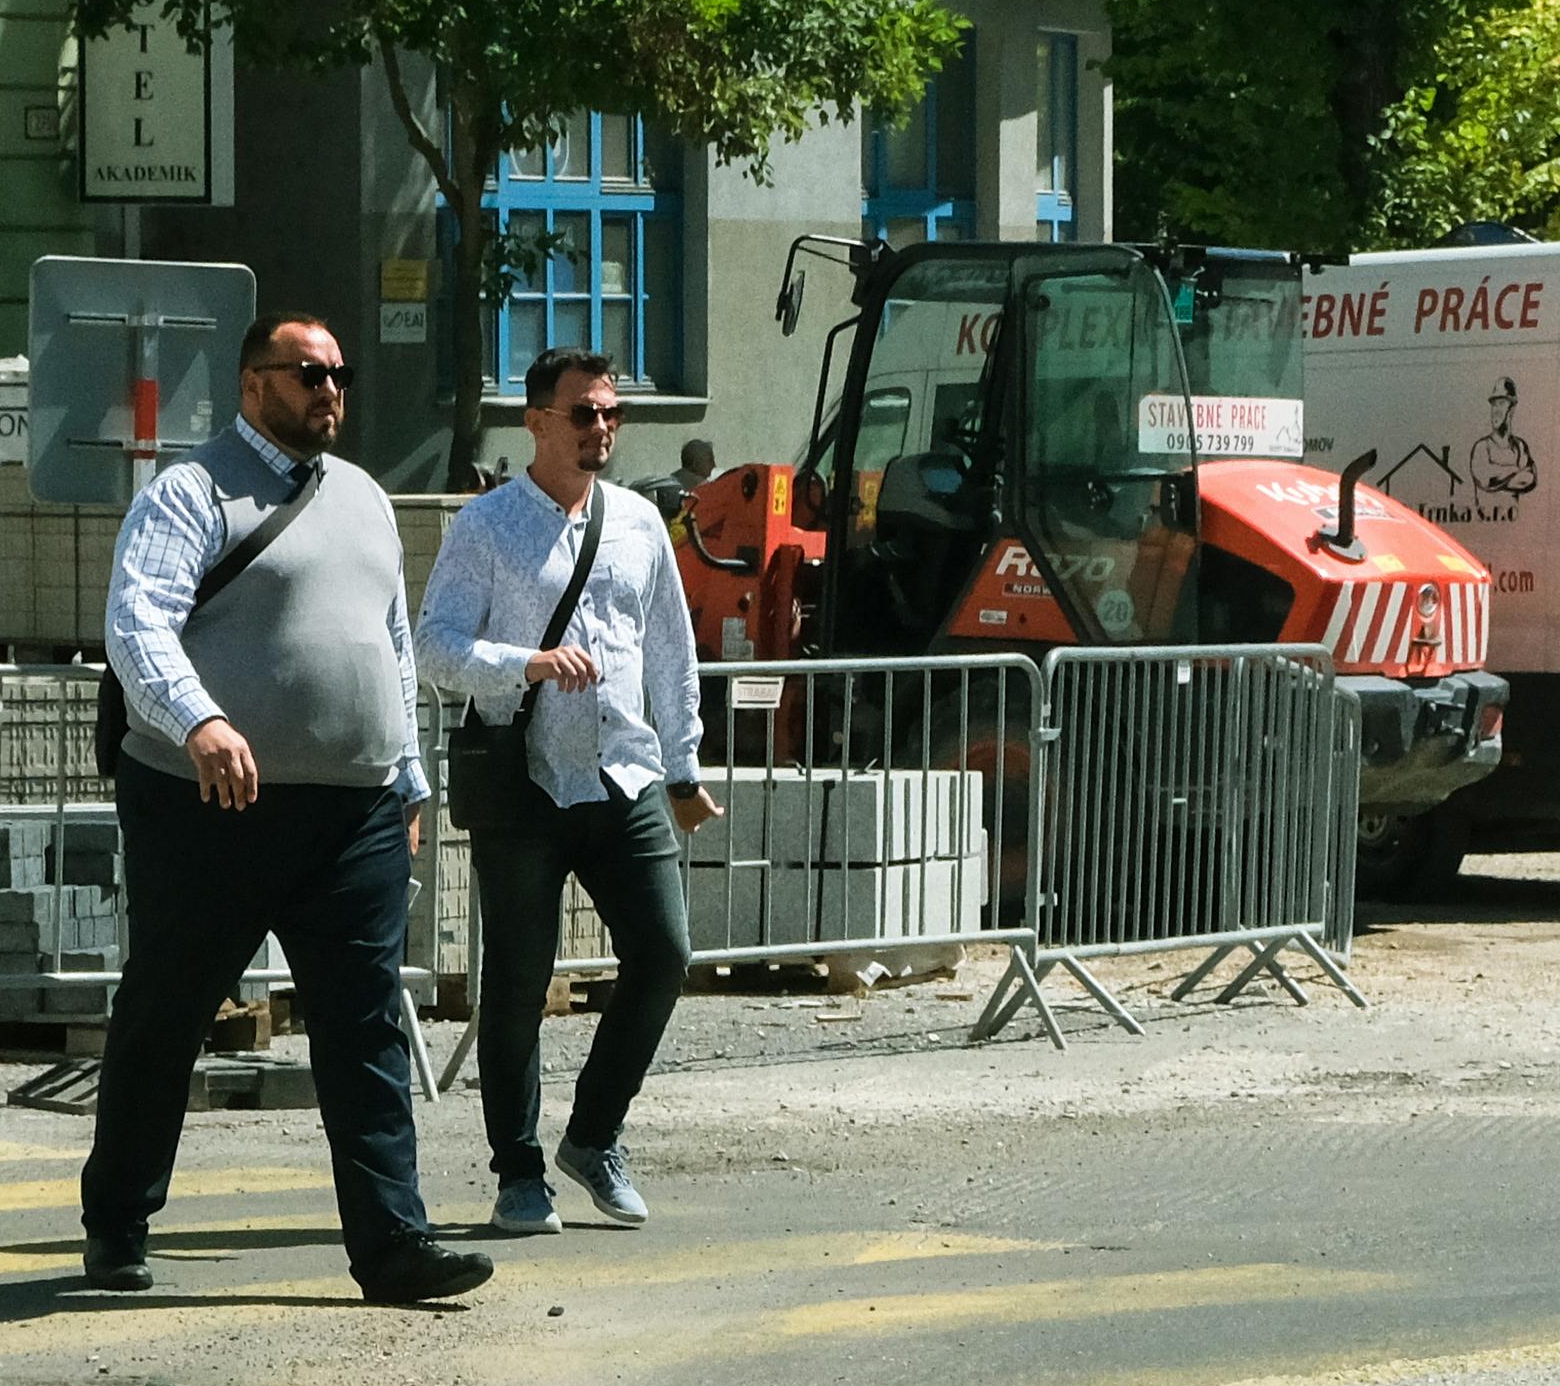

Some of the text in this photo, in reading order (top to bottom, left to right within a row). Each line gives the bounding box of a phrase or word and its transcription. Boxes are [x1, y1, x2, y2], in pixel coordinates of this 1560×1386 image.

[1414, 275, 1544, 334] PRÁCE
[1231, 402, 1266, 430] PRÁCE
[1207, 434, 1231, 452] 739
[1233, 435, 1255, 452] 799
